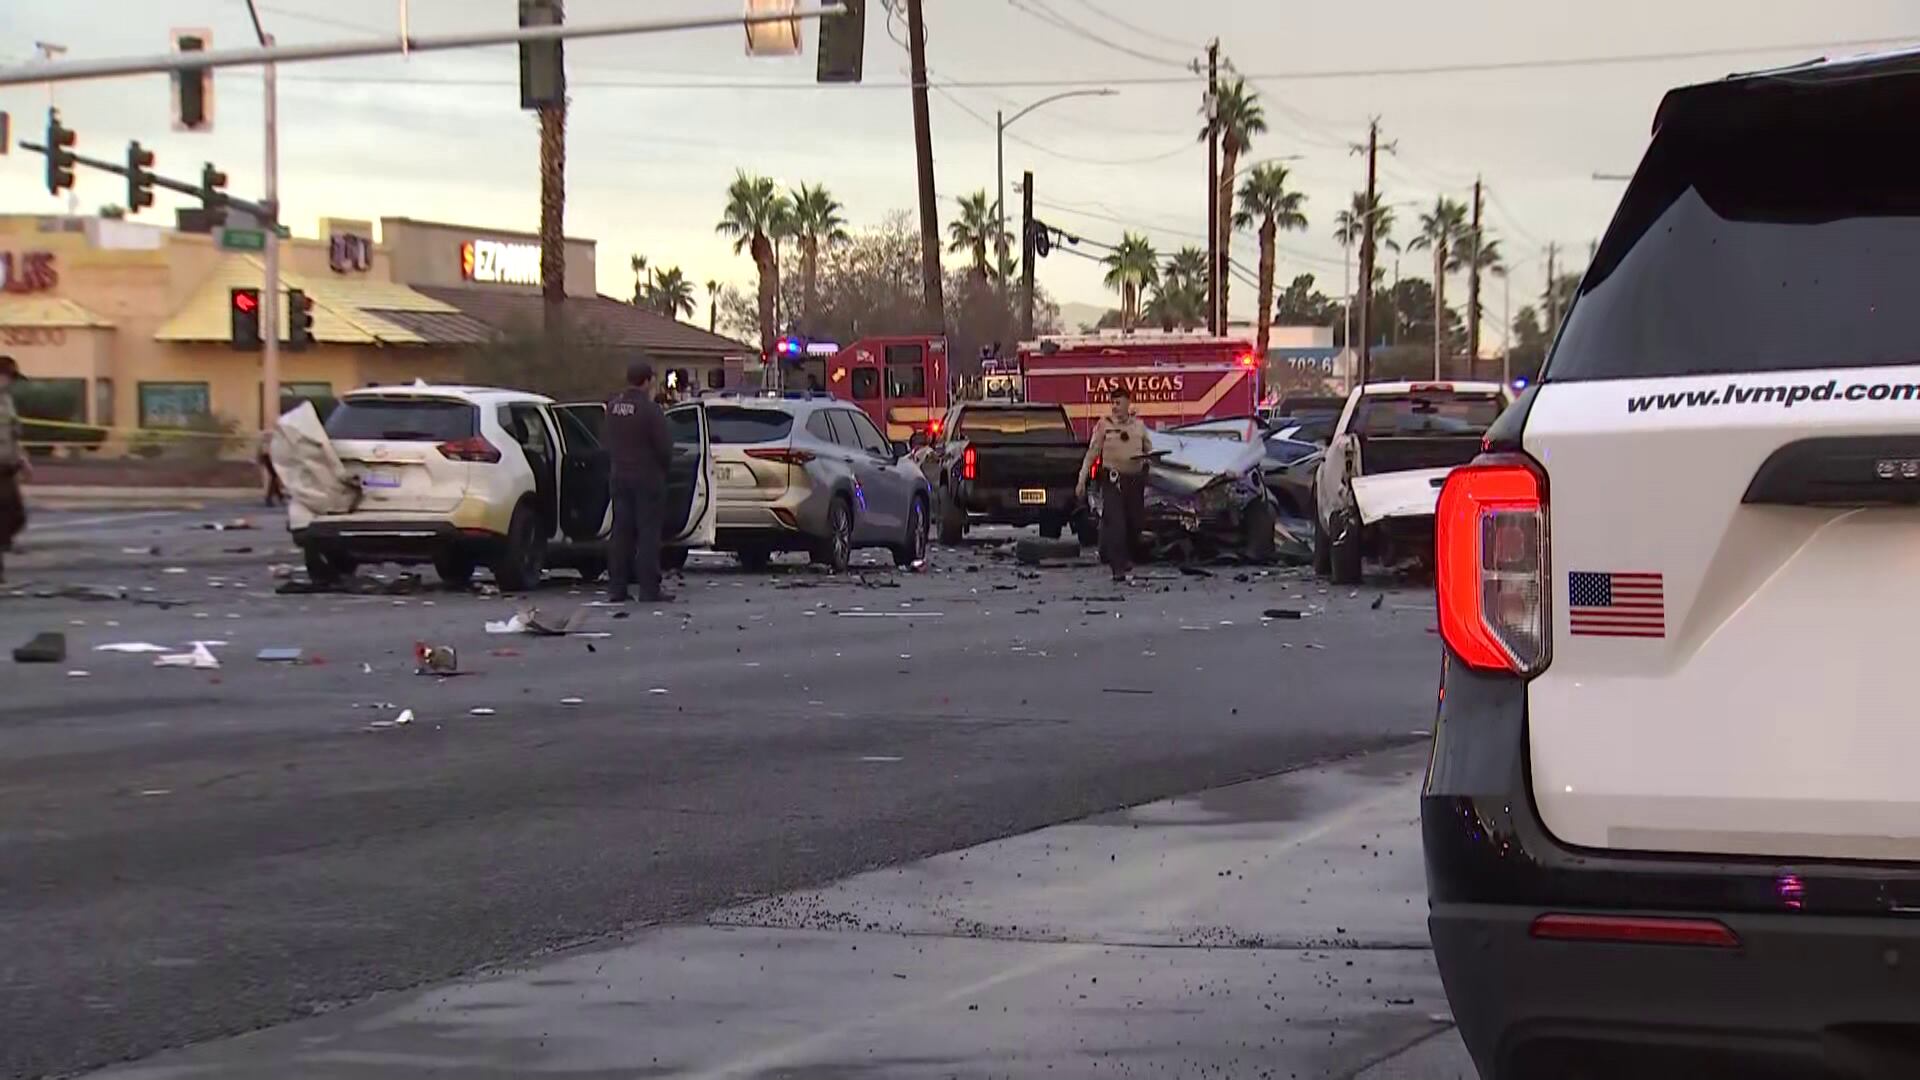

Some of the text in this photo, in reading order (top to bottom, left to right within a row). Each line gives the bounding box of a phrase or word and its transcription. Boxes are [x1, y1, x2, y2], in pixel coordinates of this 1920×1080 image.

[1086, 375, 1183, 392] LAS VEGAS
[1135, 392, 1177, 402] RESCUE
[1628, 380, 1920, 413] www.lvmpd.com
